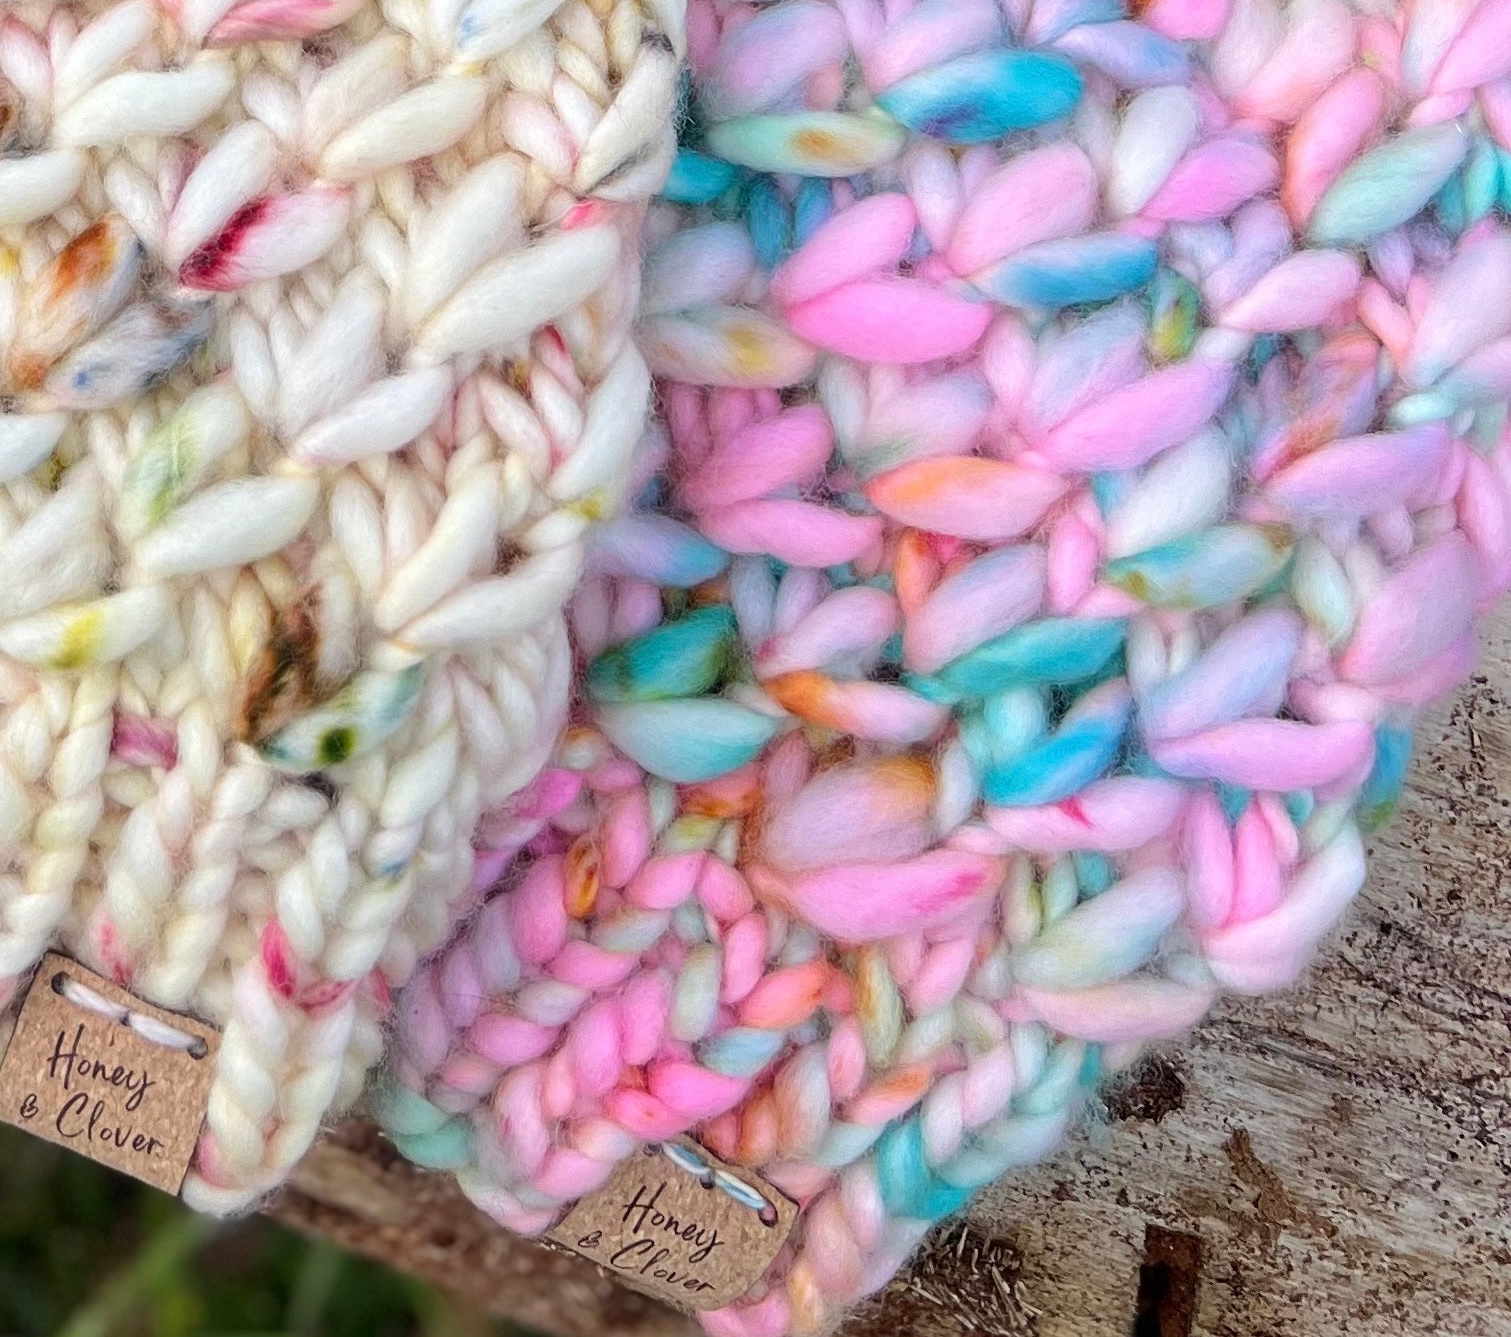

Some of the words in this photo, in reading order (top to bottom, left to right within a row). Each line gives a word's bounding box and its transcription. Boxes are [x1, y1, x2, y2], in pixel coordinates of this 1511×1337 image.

[46, 1023, 156, 1112] Honey
[20, 1093, 39, 1119] &
[55, 1092, 164, 1155] Clover
[621, 1180, 725, 1263] Honey
[577, 1229, 603, 1249] &
[609, 1238, 716, 1293] Clover
